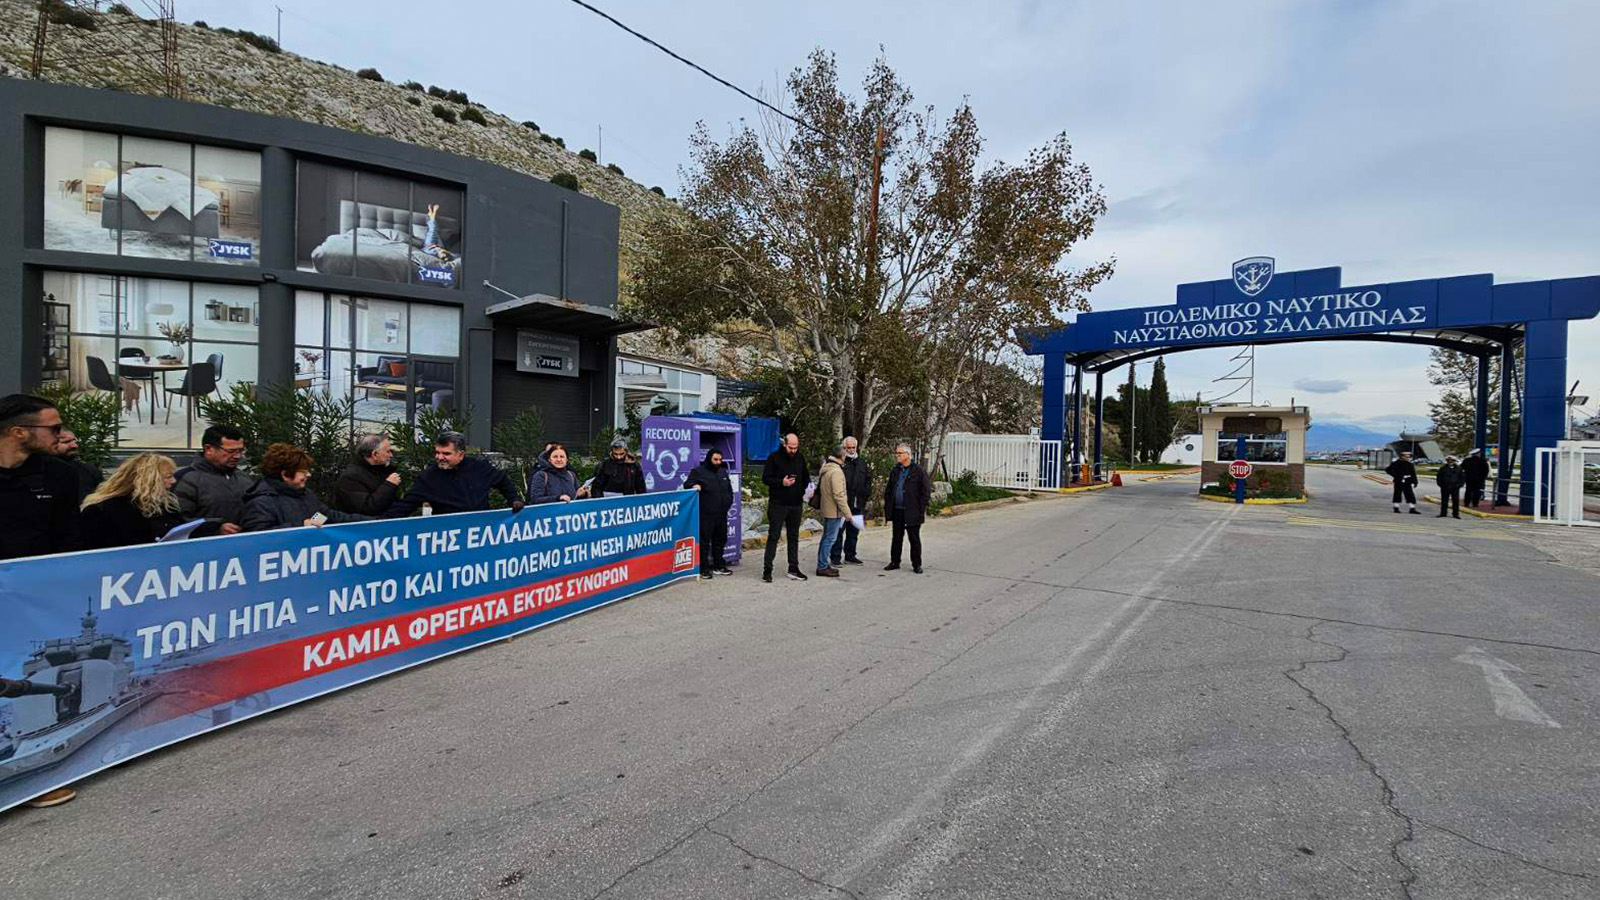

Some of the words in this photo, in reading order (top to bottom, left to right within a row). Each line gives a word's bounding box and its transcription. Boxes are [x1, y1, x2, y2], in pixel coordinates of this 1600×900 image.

[218, 244, 250, 256] JYSK
[425, 269, 452, 280] JYSK
[1143, 301, 1262, 326] ΠΟΛΕΜΙΚΟ
[1267, 290, 1382, 316] ΝΑΥΤΙΚΟ
[1113, 319, 1258, 345] ΝΑΥΣΤΑΘΜΟΣ
[1263, 305, 1427, 334] ΣΑΛΑΜΙΝΑΣ
[541, 359, 561, 368] JYSK
[645, 427, 691, 441] RECYCOM
[1231, 465, 1249, 475] STOP
[100, 557, 247, 610] ΚΑΜΙΑ
[258, 535, 410, 582] ΕΜΠΛΟΚΗ
[416, 529, 461, 556] ΤΗΣ
[467, 517, 552, 549] ΕΛΛΑΔΑΣ
[555, 511, 598, 534] ΣΤΟΥΣ
[600, 501, 681, 528] ΣΧΕΔΙΑΣΜΟΥΣ
[136, 613, 217, 659] ΤΩΝ
[228, 598, 297, 639] ΗΠΑ
[306, 605, 319, 614] -
[328, 578, 398, 616] ΝΑΤΟ
[404, 570, 443, 599] ΚΑΙ
[449, 561, 489, 589] ΤΟΝ
[494, 550, 560, 581] ΠΟΛΕΜΟ
[564, 543, 588, 565] ΣΤΗ
[590, 536, 624, 560] ΜΕΣΗ
[626, 526, 673, 552] ΑΝΑΤΟΛΗ
[303, 624, 401, 671] ΚΑΜΙΑ
[408, 598, 509, 640] ΦΡΕΓΑΤΑ
[513, 582, 564, 614] ΕΚΤΟΣ
[566, 564, 629, 598] ΣΥΝΟΡΩΝ
